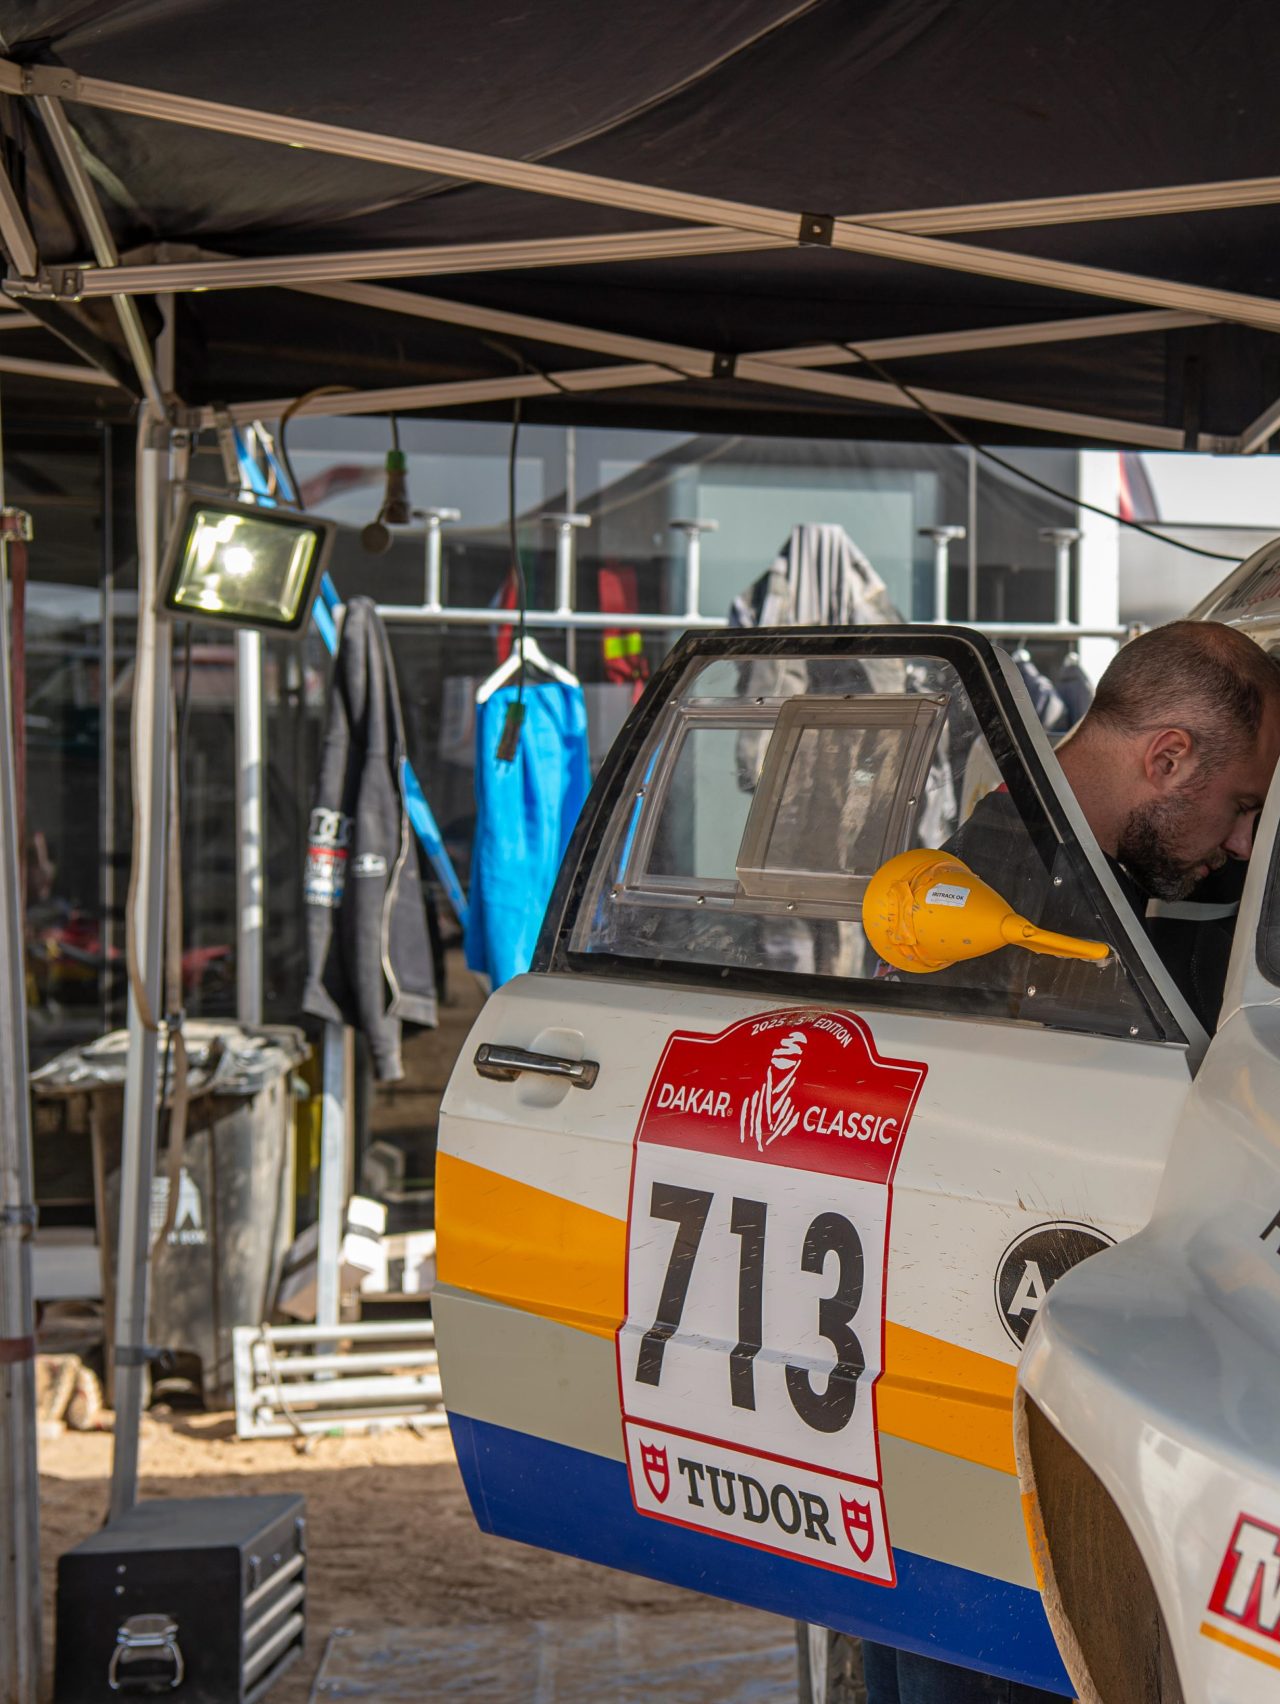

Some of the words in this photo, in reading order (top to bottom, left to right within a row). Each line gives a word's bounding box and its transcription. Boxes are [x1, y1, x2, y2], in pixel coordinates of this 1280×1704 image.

[750, 1017, 787, 1037] 2025
[813, 1018, 853, 1049] EDITION
[656, 1083, 731, 1118] DAKAR
[802, 1106, 898, 1145] CLASSIC
[635, 1181, 866, 1434] 713
[677, 1457, 837, 1546] TUDOR
